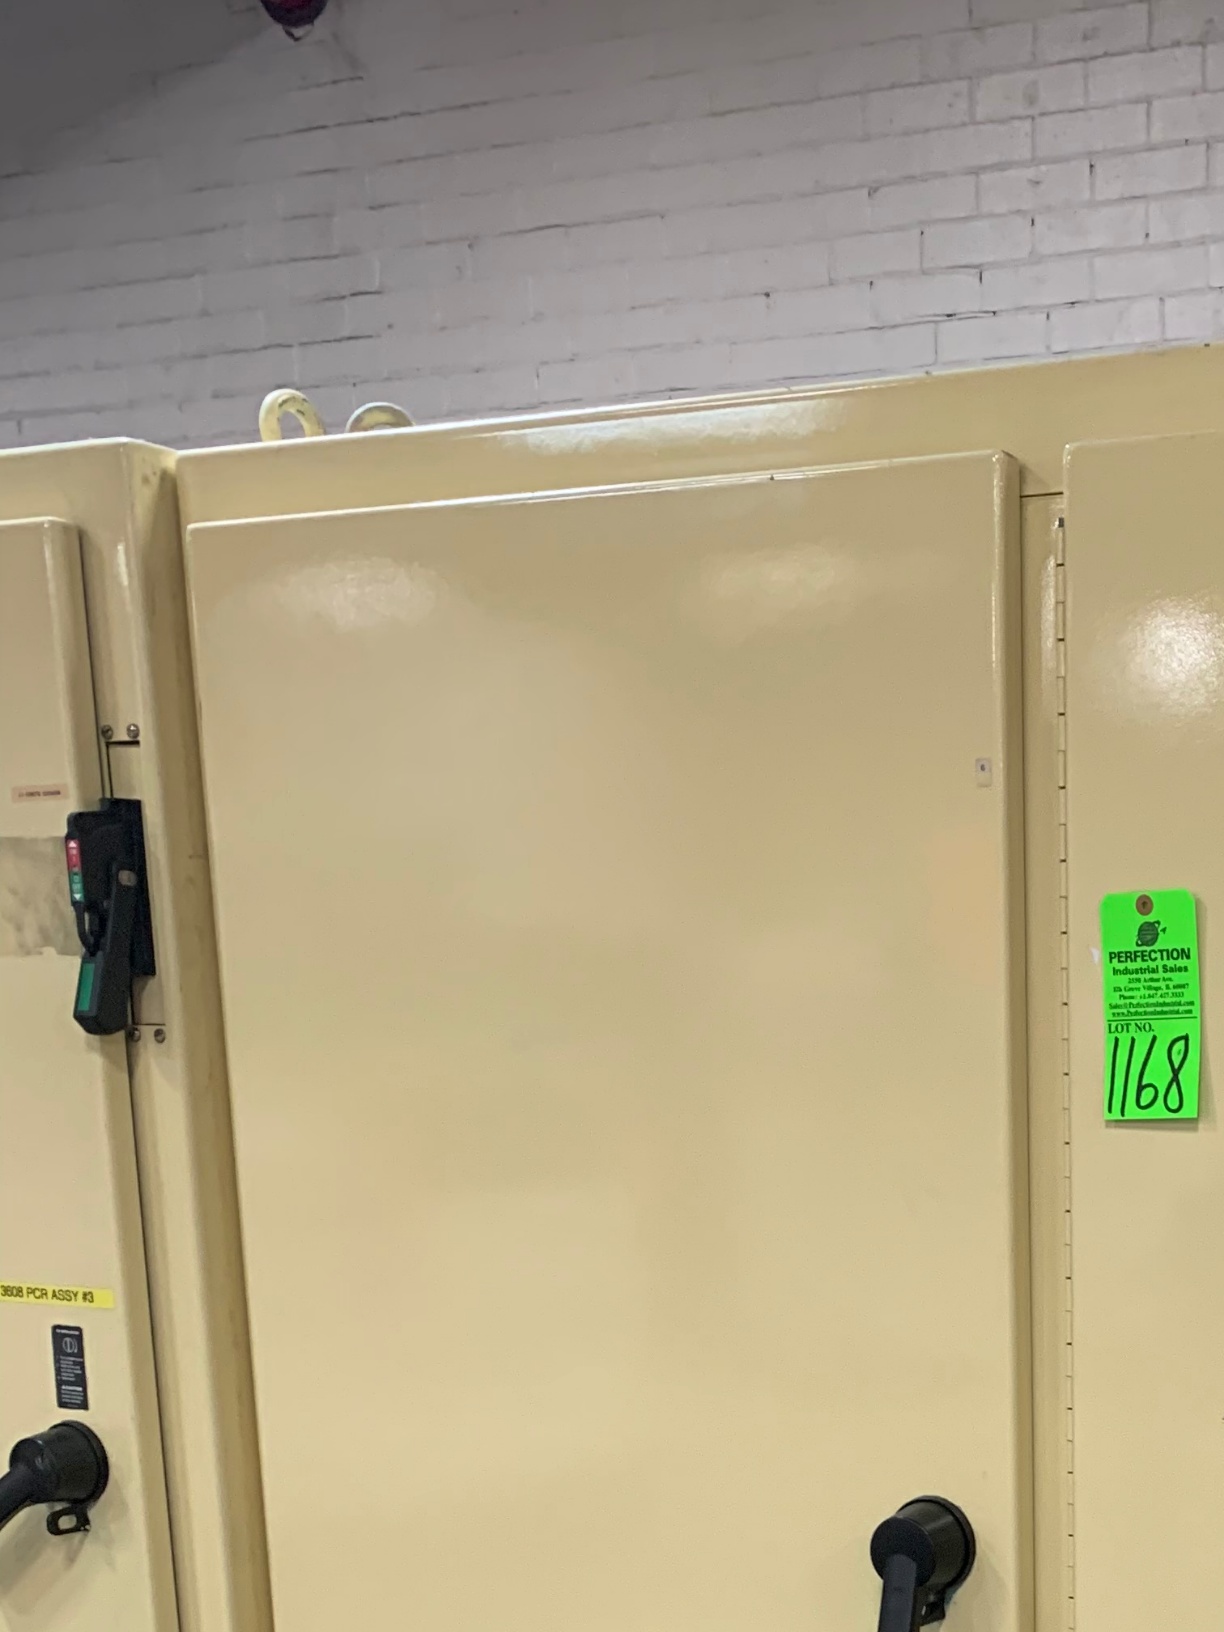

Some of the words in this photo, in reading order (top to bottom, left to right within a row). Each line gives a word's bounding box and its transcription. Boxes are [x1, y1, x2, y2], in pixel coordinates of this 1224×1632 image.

[1108, 947, 1191, 964] PERFECTION
[1112, 965, 1159, 976] Industrial
[1162, 964, 1189, 974] Sales
[1107, 1023, 1131, 1034] LOT
[1134, 1022, 1155, 1033] NO.
[1107, 1033, 1190, 1117] 1168
[0, 1284, 24, 1298] 3608
[26, 1287, 48, 1300] PCR
[51, 1289, 79, 1302] ASSY
[82, 1291, 94, 1303] #3
